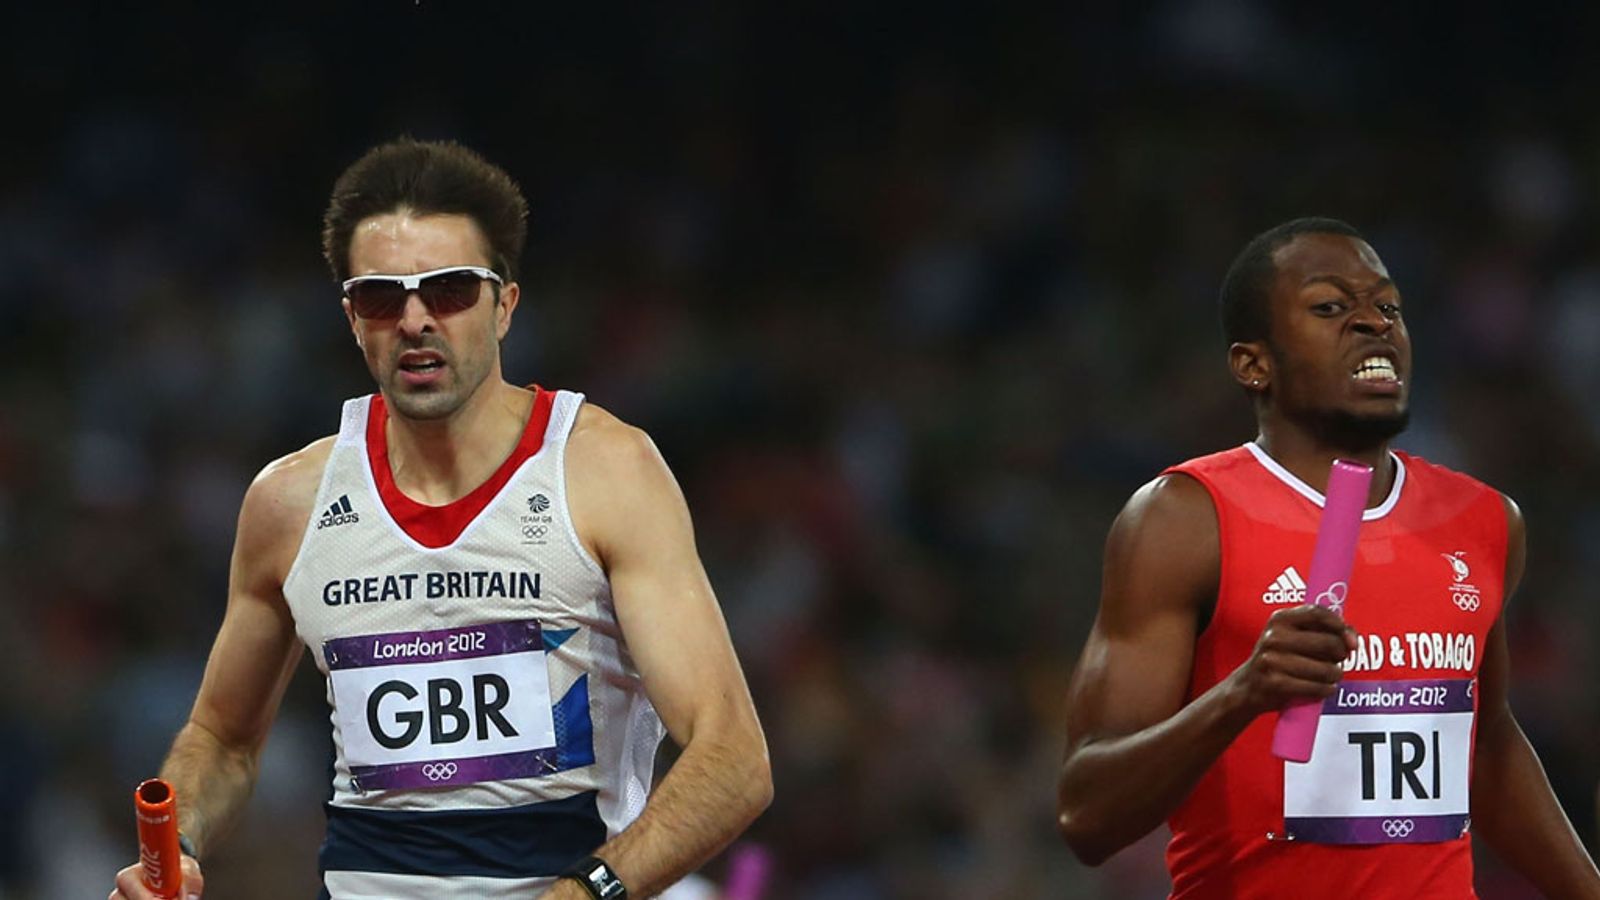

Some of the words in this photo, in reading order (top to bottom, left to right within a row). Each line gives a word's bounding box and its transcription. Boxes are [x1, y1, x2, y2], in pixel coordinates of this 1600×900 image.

[520, 515, 541, 524] TEAM
[323, 574, 418, 606] GREAT
[426, 571, 541, 599] BRITAIN
[1262, 588, 1306, 604] adida
[373, 637, 443, 659] London
[448, 632, 486, 652] 2012
[1390, 636, 1405, 667] &
[1405, 632, 1475, 671] TOBAGO
[366, 673, 519, 750] GBR
[1337, 687, 1404, 708] London
[1409, 687, 1447, 706] 2012
[1348, 731, 1441, 801] TRI
